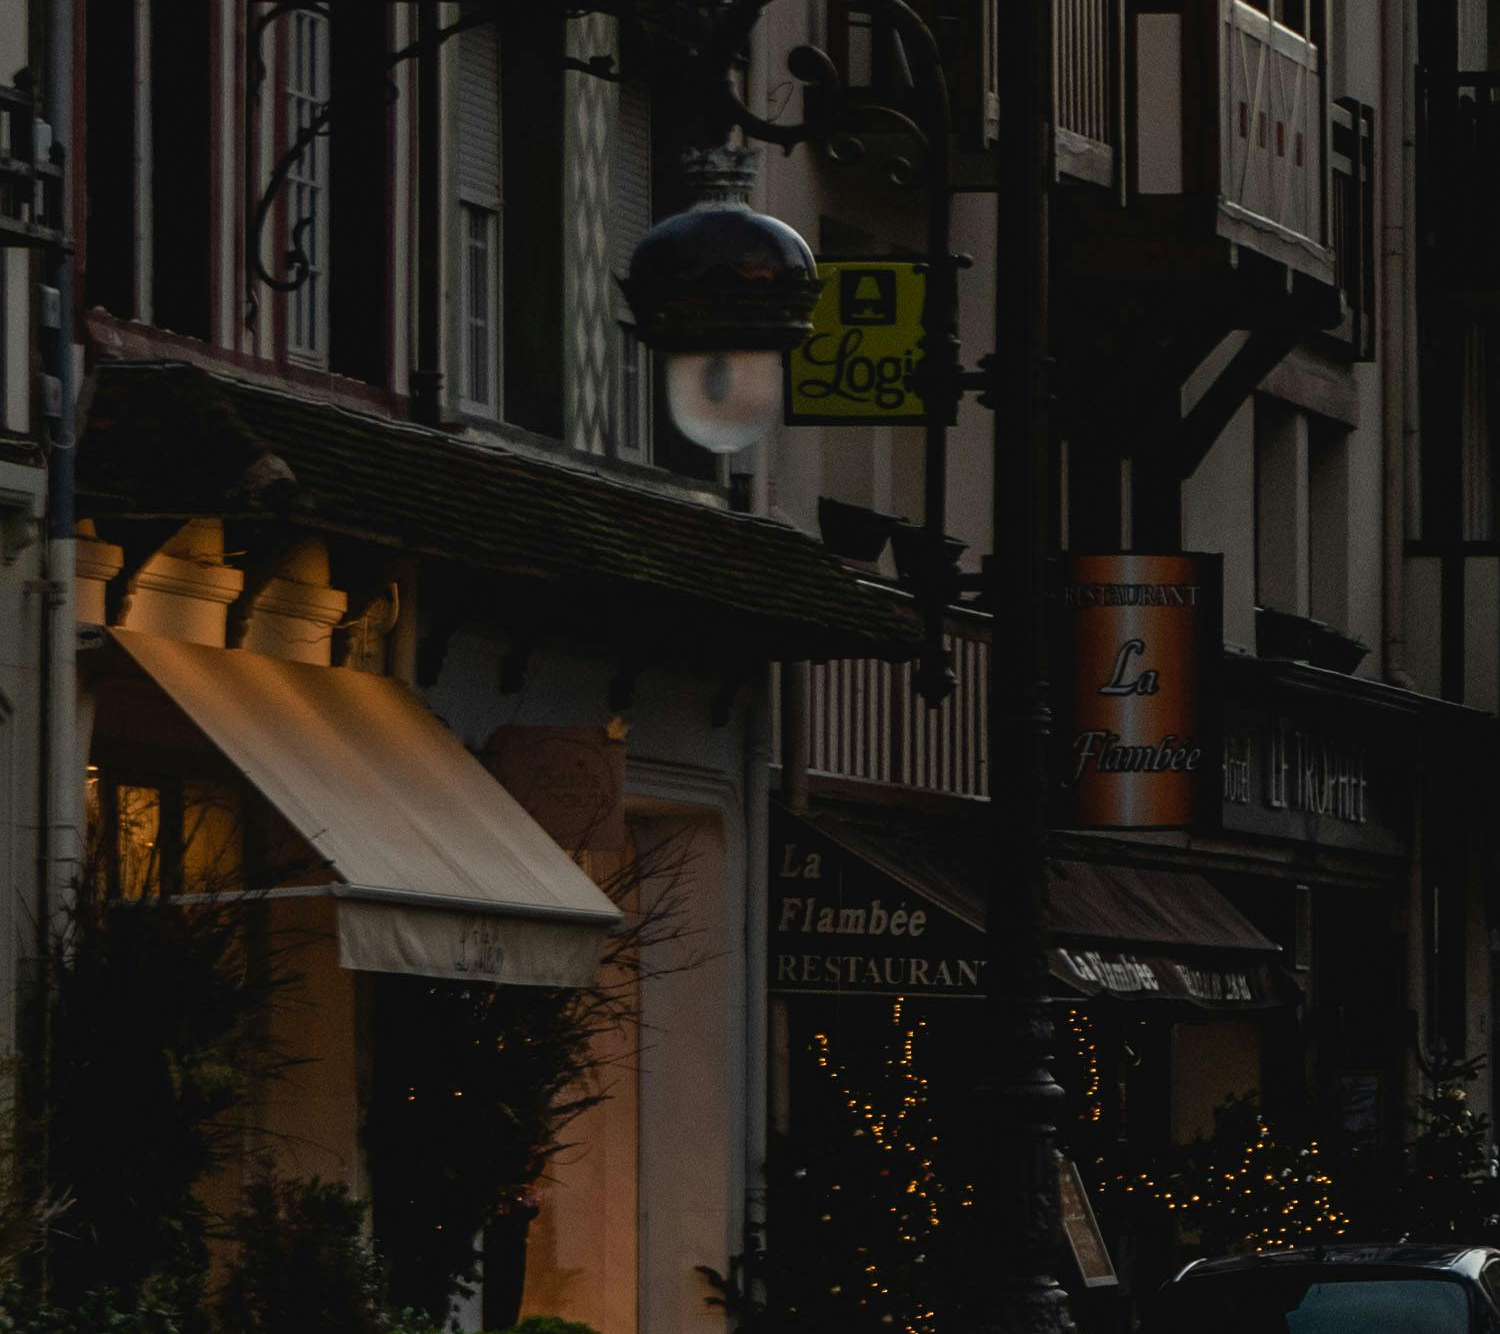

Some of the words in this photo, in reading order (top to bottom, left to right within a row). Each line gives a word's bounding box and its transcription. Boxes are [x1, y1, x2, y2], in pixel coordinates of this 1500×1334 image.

[797, 328, 918, 409] Logi
[1064, 585, 1201, 607] RESTAURANT
[1098, 638, 1159, 695] La
[1060, 730, 1202, 788] Flambée
[779, 842, 823, 880] La
[776, 896, 928, 938] Flambée
